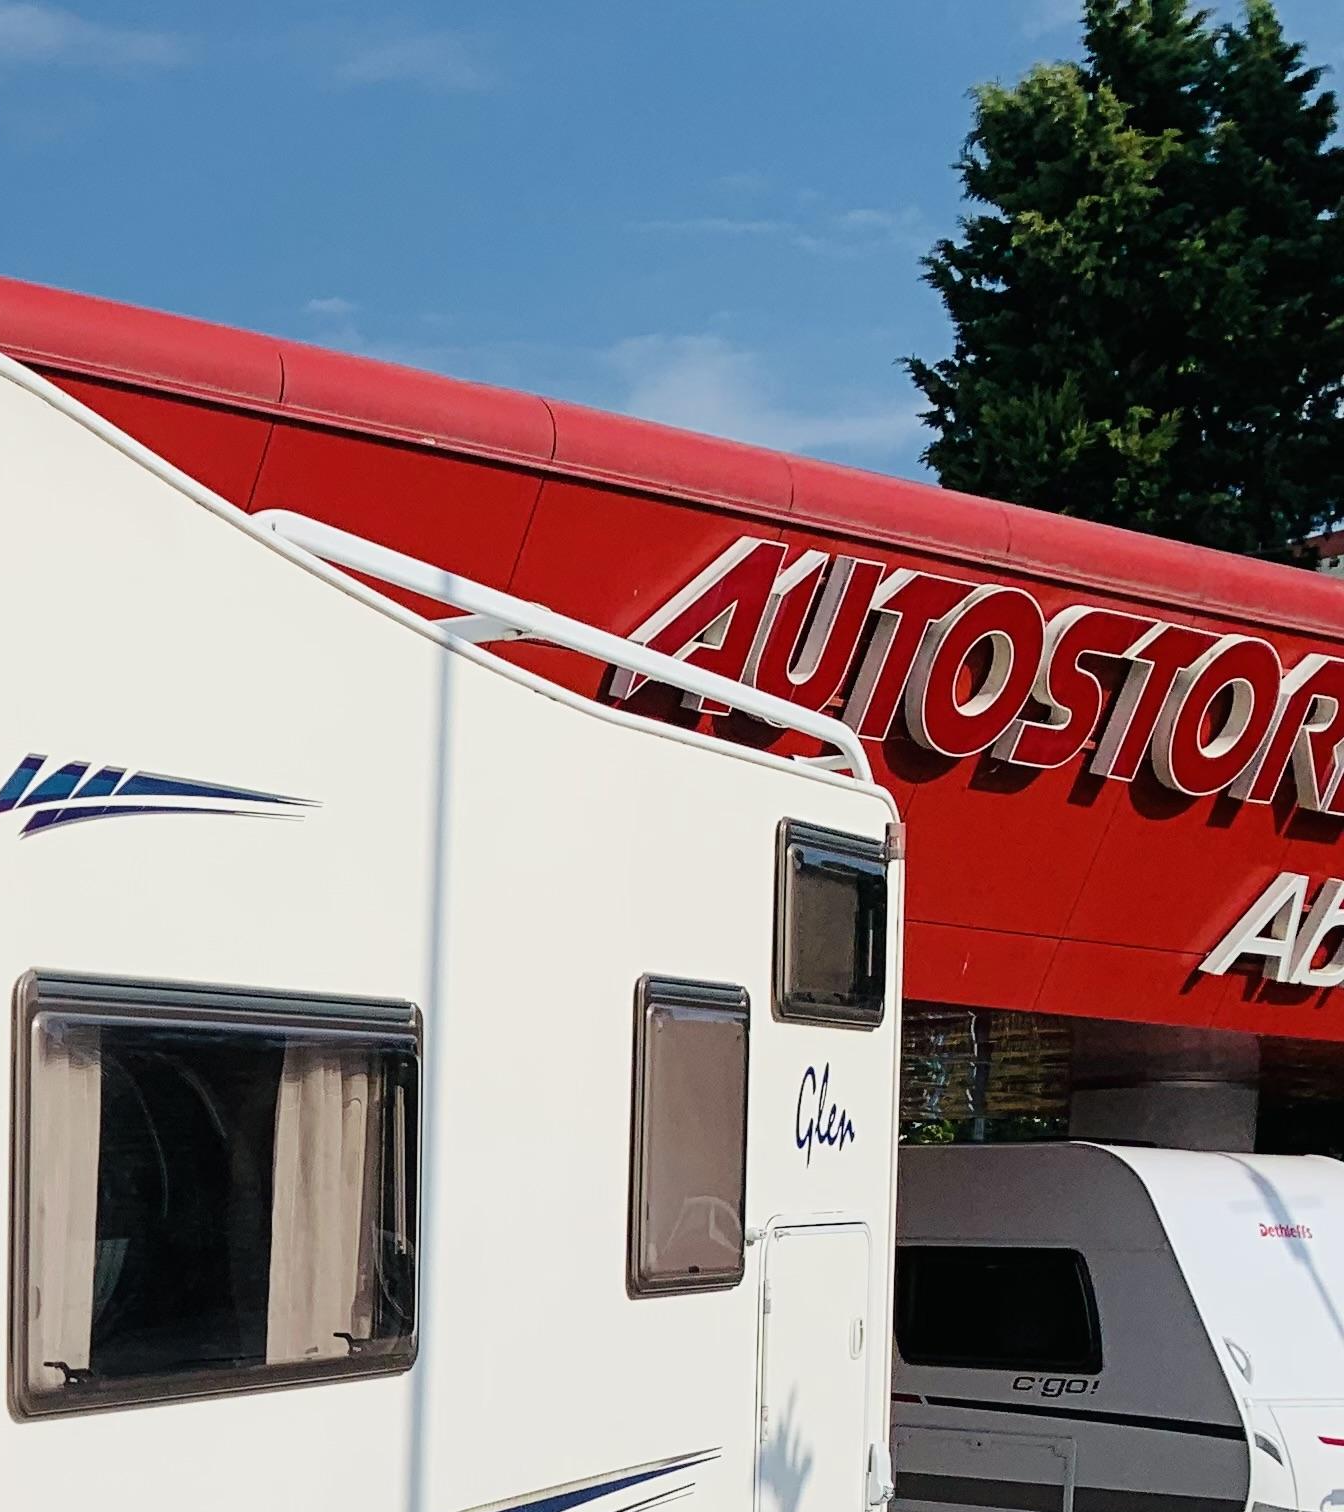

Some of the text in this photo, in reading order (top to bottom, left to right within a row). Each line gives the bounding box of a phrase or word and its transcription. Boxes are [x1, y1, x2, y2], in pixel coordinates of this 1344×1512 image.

[609, 535, 1344, 816] AUTOSTOR
[795, 1061, 855, 1169] Glen
[1258, 1222, 1313, 1239] Dethleffs
